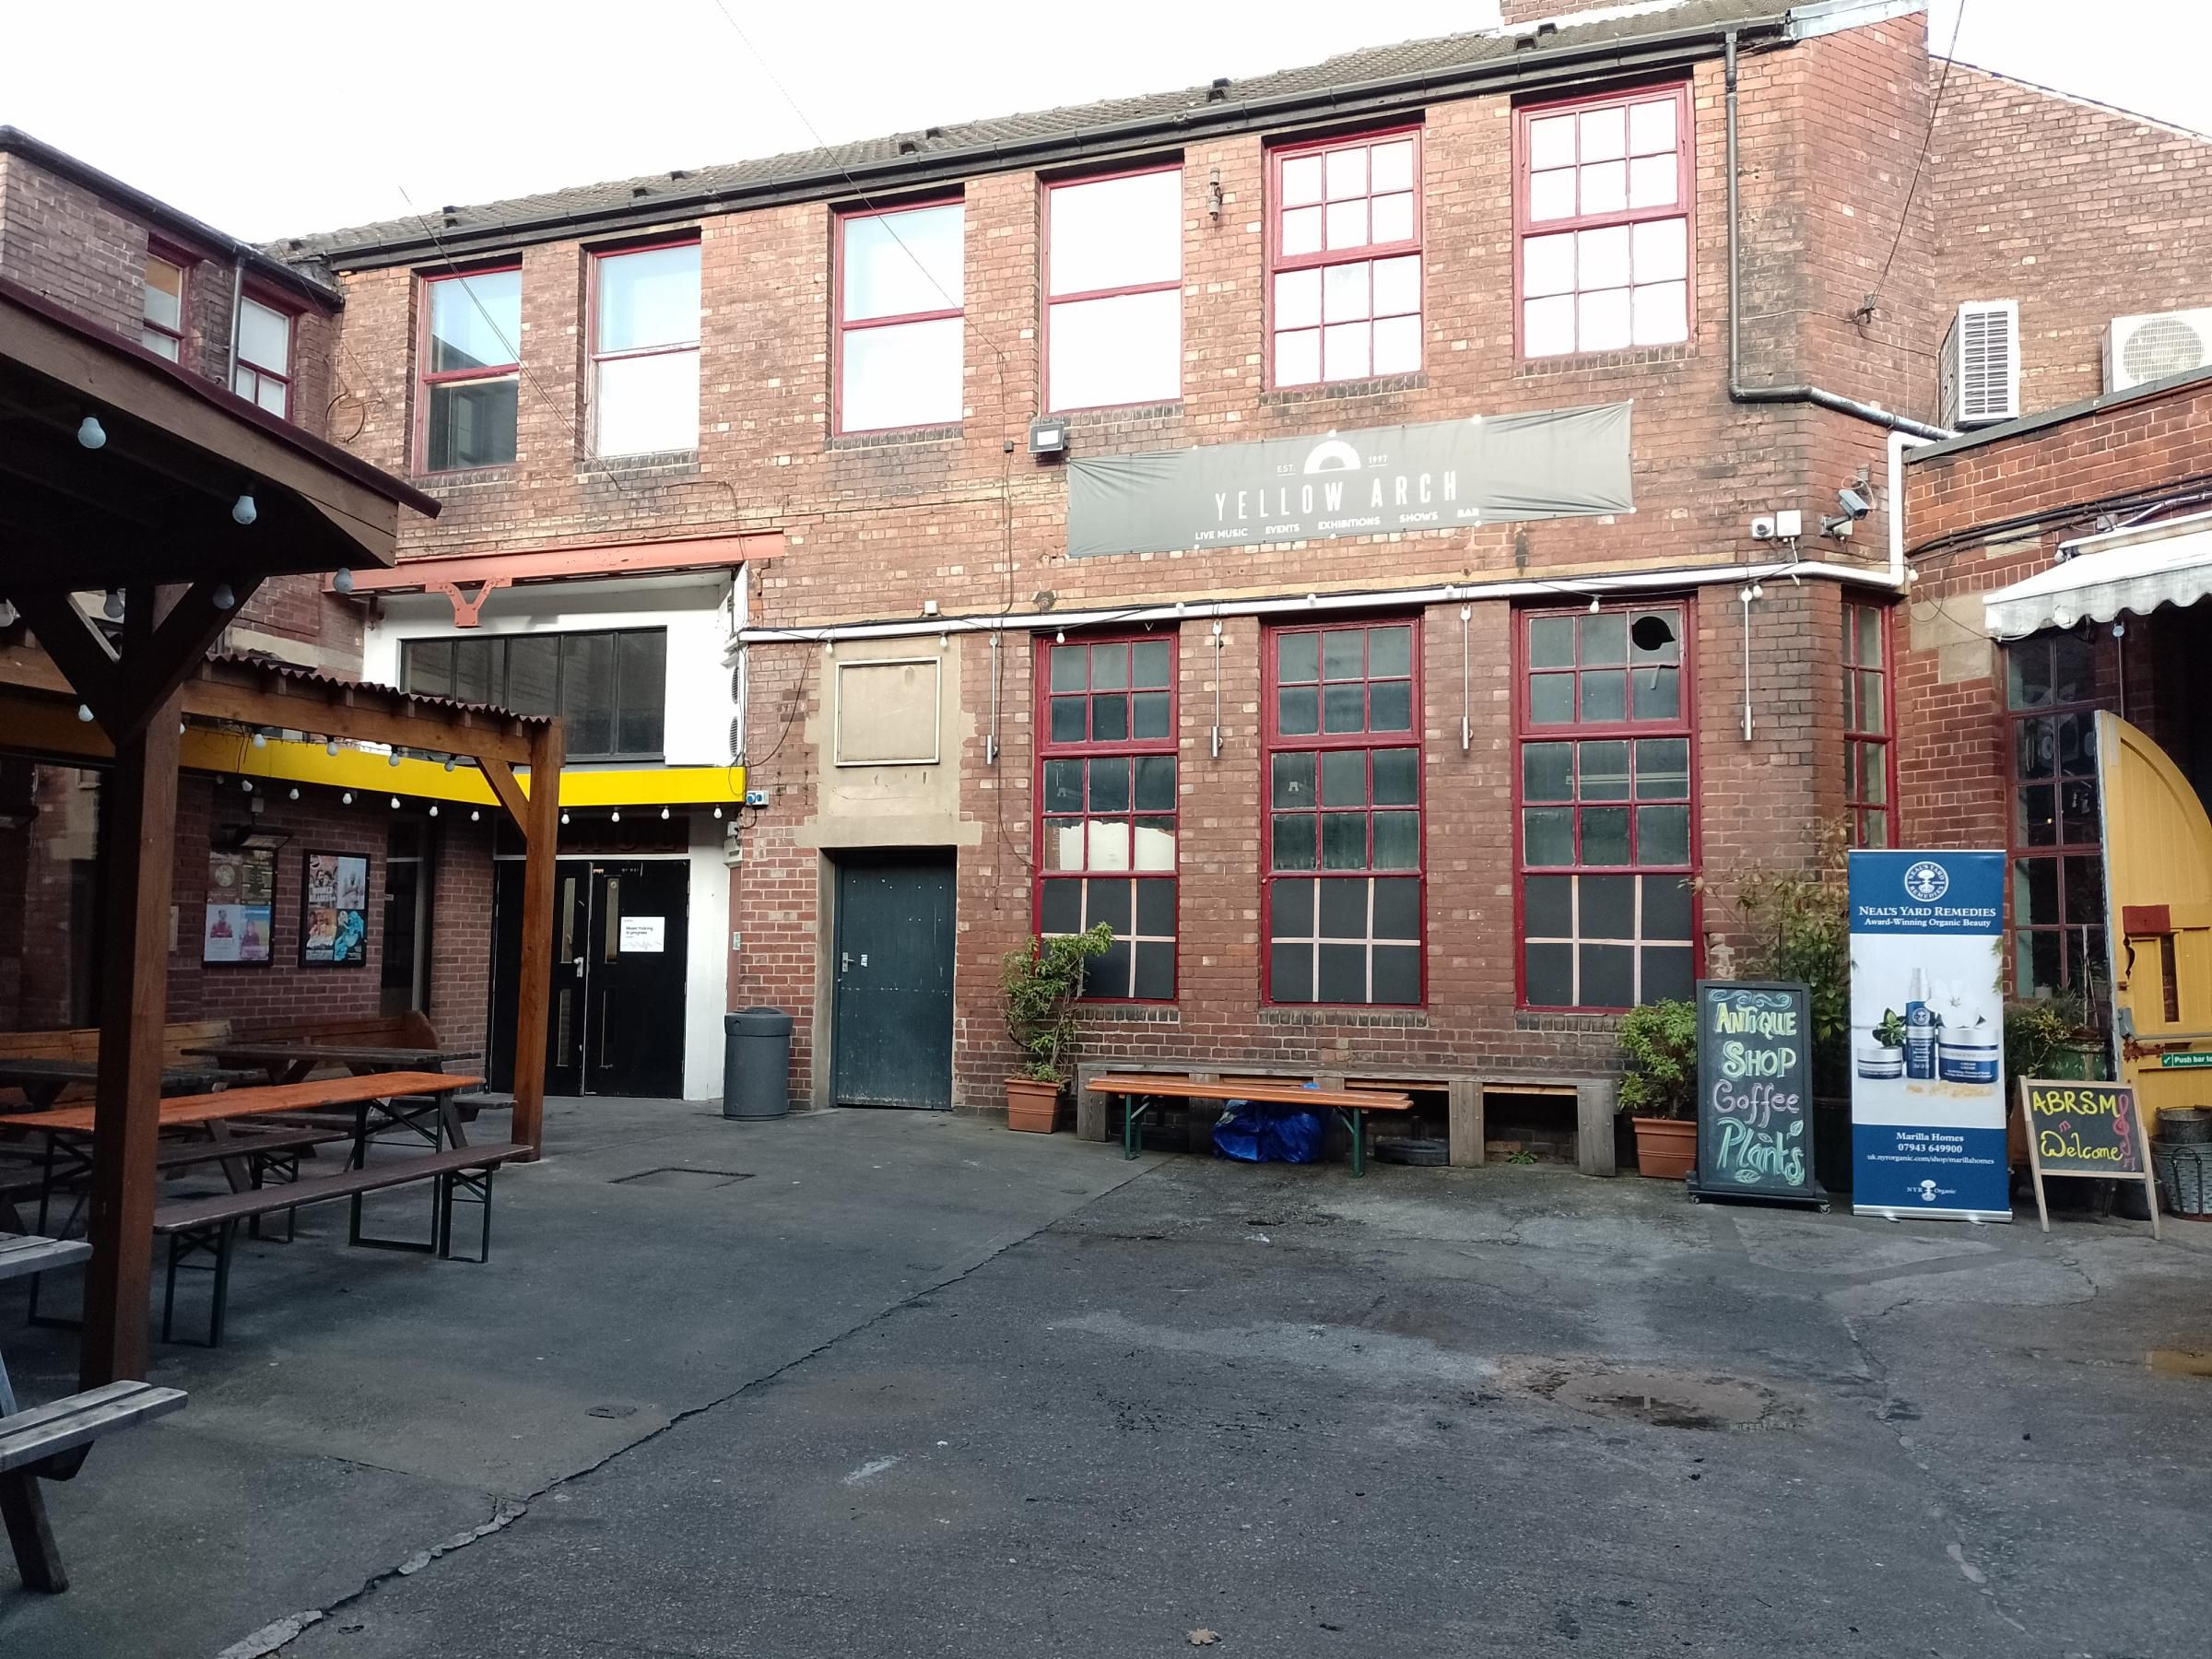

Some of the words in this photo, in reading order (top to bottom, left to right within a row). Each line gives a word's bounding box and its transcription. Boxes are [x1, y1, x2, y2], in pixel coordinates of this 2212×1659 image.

[1277, 464, 1296, 473] EST.
[1369, 455, 1388, 465] 1997
[1215, 480, 1344, 522] YELLOW
[1371, 471, 1457, 509] ARCH
[1194, 529, 1215, 540] LIVE
[1217, 527, 1249, 539] MUSIC
[1265, 523, 1300, 535] EVENTS
[1318, 515, 1382, 531] EXHIBITIONS
[1399, 511, 1439, 524] SHOWS
[1457, 508, 1480, 518] BAR
[1909, 886, 1944, 899] REMEDIES
[1858, 906, 1898, 916] NEAL'S
[1899, 906, 1932, 916] YARD
[1935, 907, 1996, 917] REMEDIES
[1865, 918, 1927, 927] Award-Winning
[1929, 918, 1961, 927] Organic
[1963, 919, 1991, 928] Beauty
[1722, 1040, 1796, 1078] SHOP
[1713, 1078, 1800, 1128] Coffee
[2032, 1090, 2121, 1118] ABRSM
[1716, 1116, 1806, 1183] Plants
[1896, 1132, 1929, 1141] Marilla
[1932, 1133, 1964, 1142] Homes
[1898, 1143, 1926, 1152] 07943
[1928, 1144, 1963, 1153] 649900
[2041, 1130, 2124, 1161] Welcome
